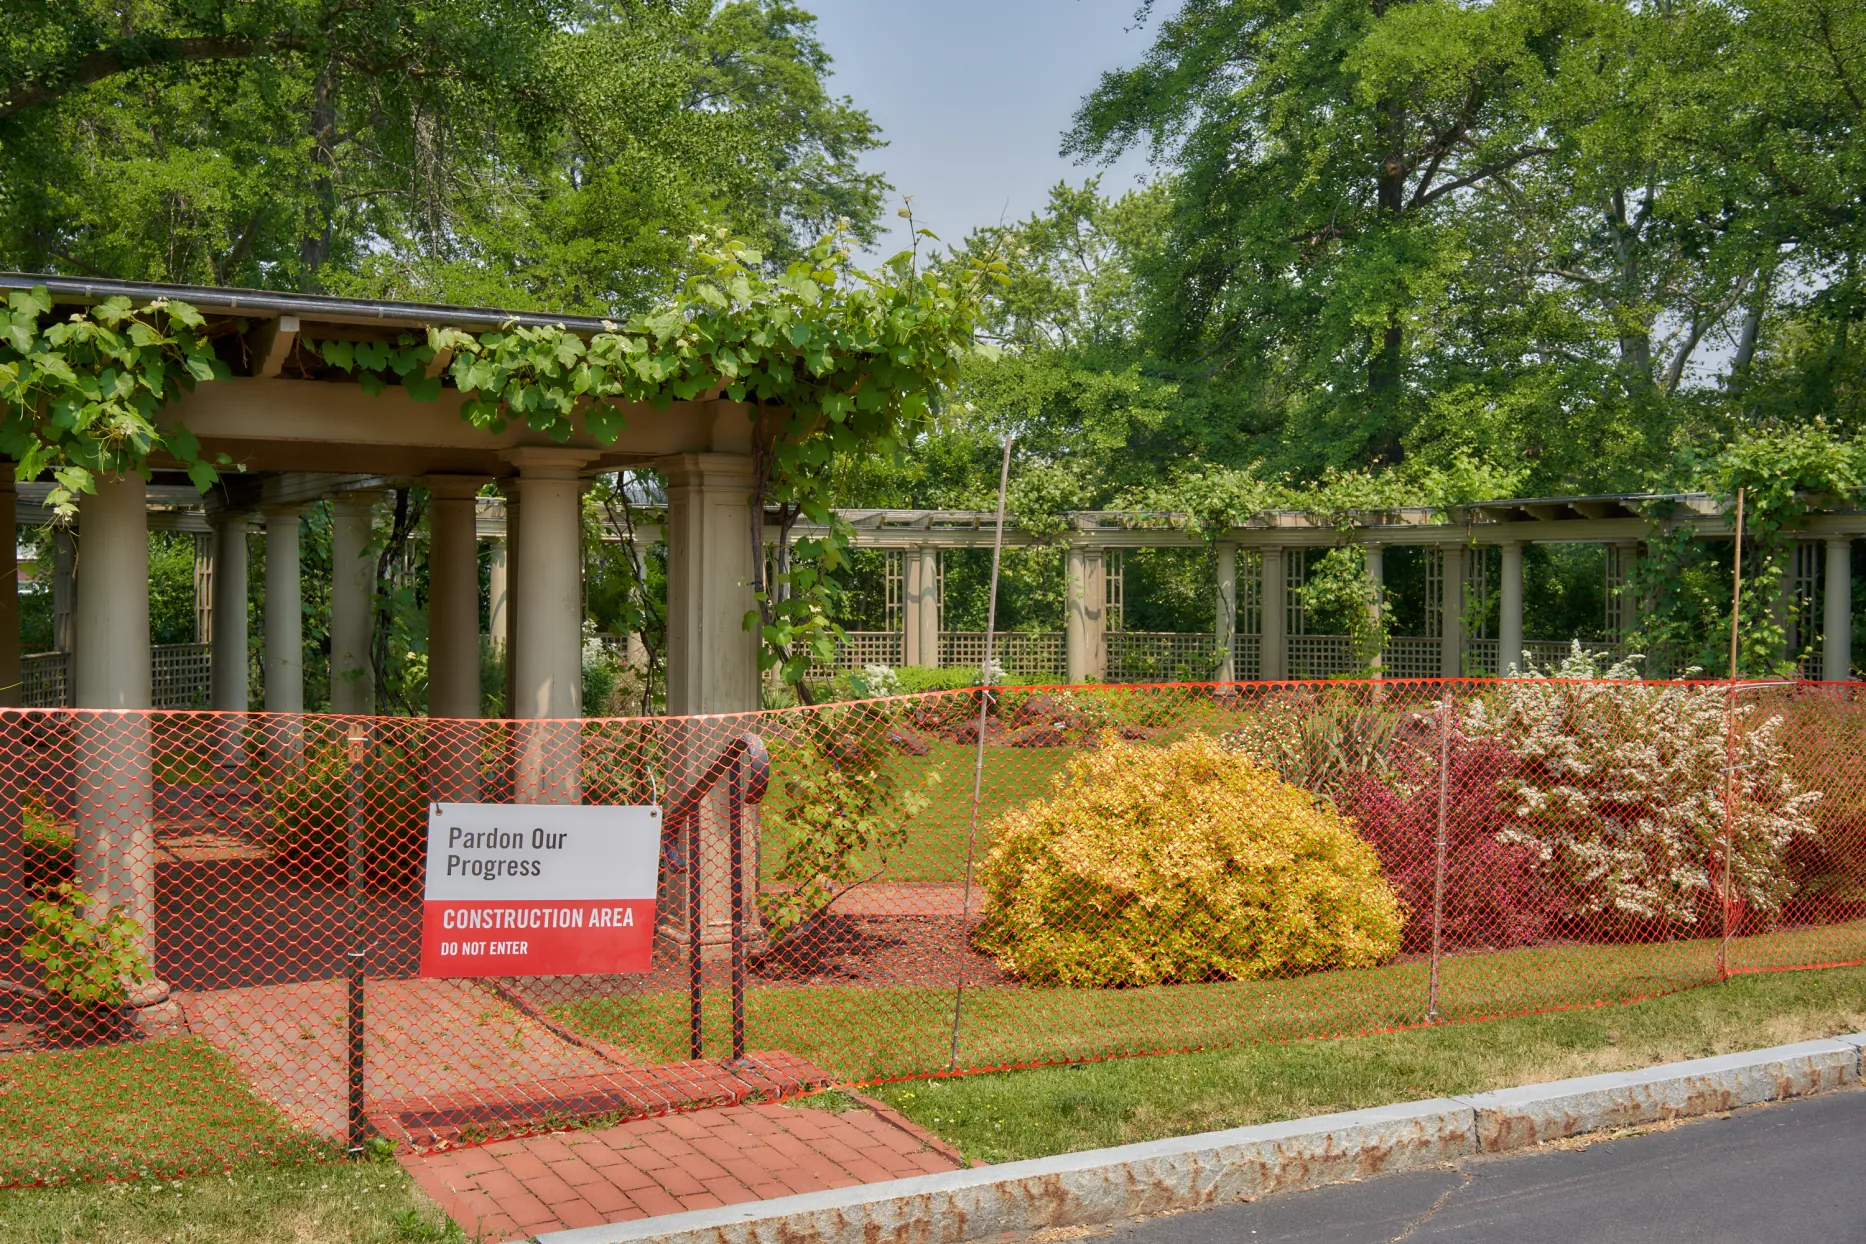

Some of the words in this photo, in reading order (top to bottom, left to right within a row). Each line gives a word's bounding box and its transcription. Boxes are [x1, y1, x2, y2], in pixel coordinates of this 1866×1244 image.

[448, 827, 524, 849] Pardon
[531, 828, 568, 849] Our
[446, 855, 541, 881] Progress
[443, 908, 584, 929] CONSTRUCTION
[588, 907, 634, 928] AREA
[440, 942, 458, 956] DO
[461, 941, 486, 955] NOT
[489, 941, 528, 955] ENTER
